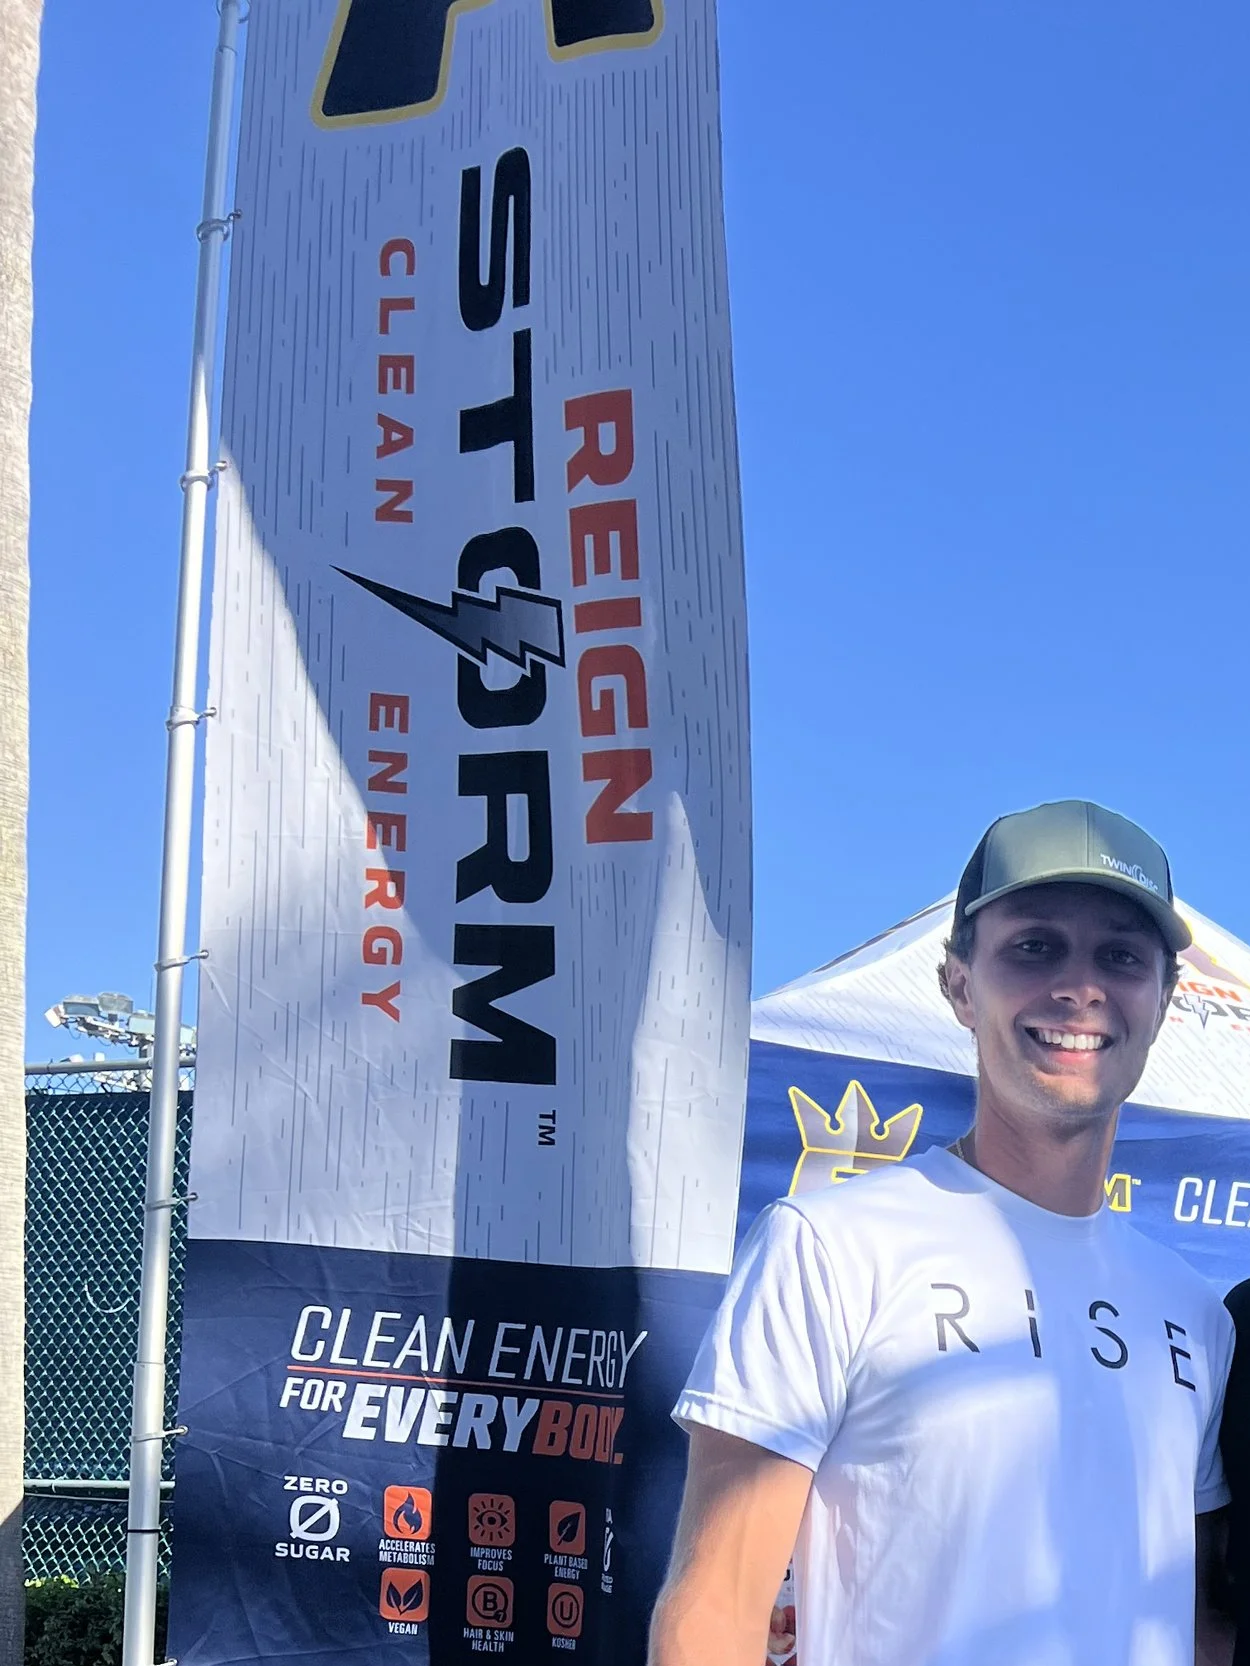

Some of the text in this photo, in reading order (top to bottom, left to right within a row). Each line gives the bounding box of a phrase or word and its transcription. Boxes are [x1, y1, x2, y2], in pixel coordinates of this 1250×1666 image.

[449, 146, 557, 1086] STORM
[564, 388, 654, 845] REIGN
[361, 238, 416, 1023] CLEAN ENERGY
[1100, 853, 1132, 876] TWIN
[1177, 981, 1243, 1003] IGN
[290, 1305, 648, 1389] CLEAN ENERGY
[279, 1376, 346, 1413] FOR
[284, 1475, 348, 1495] ZERO
[275, 1543, 350, 1563] SUGAR
[379, 1538, 436, 1554] ACCELERATES
[470, 1546, 513, 1561] IMPROVES
[379, 1550, 435, 1566] METABOLISM
[477, 1559, 504, 1572] FOCUS
[544, 1553, 567, 1566] PLANT
[554, 1566, 580, 1580] ENERGY
[388, 1621, 418, 1636] VEGAN
[463, 1627, 484, 1640] HAIR
[493, 1629, 514, 1643] SKIN
[471, 1639, 504, 1653] HEALTH
